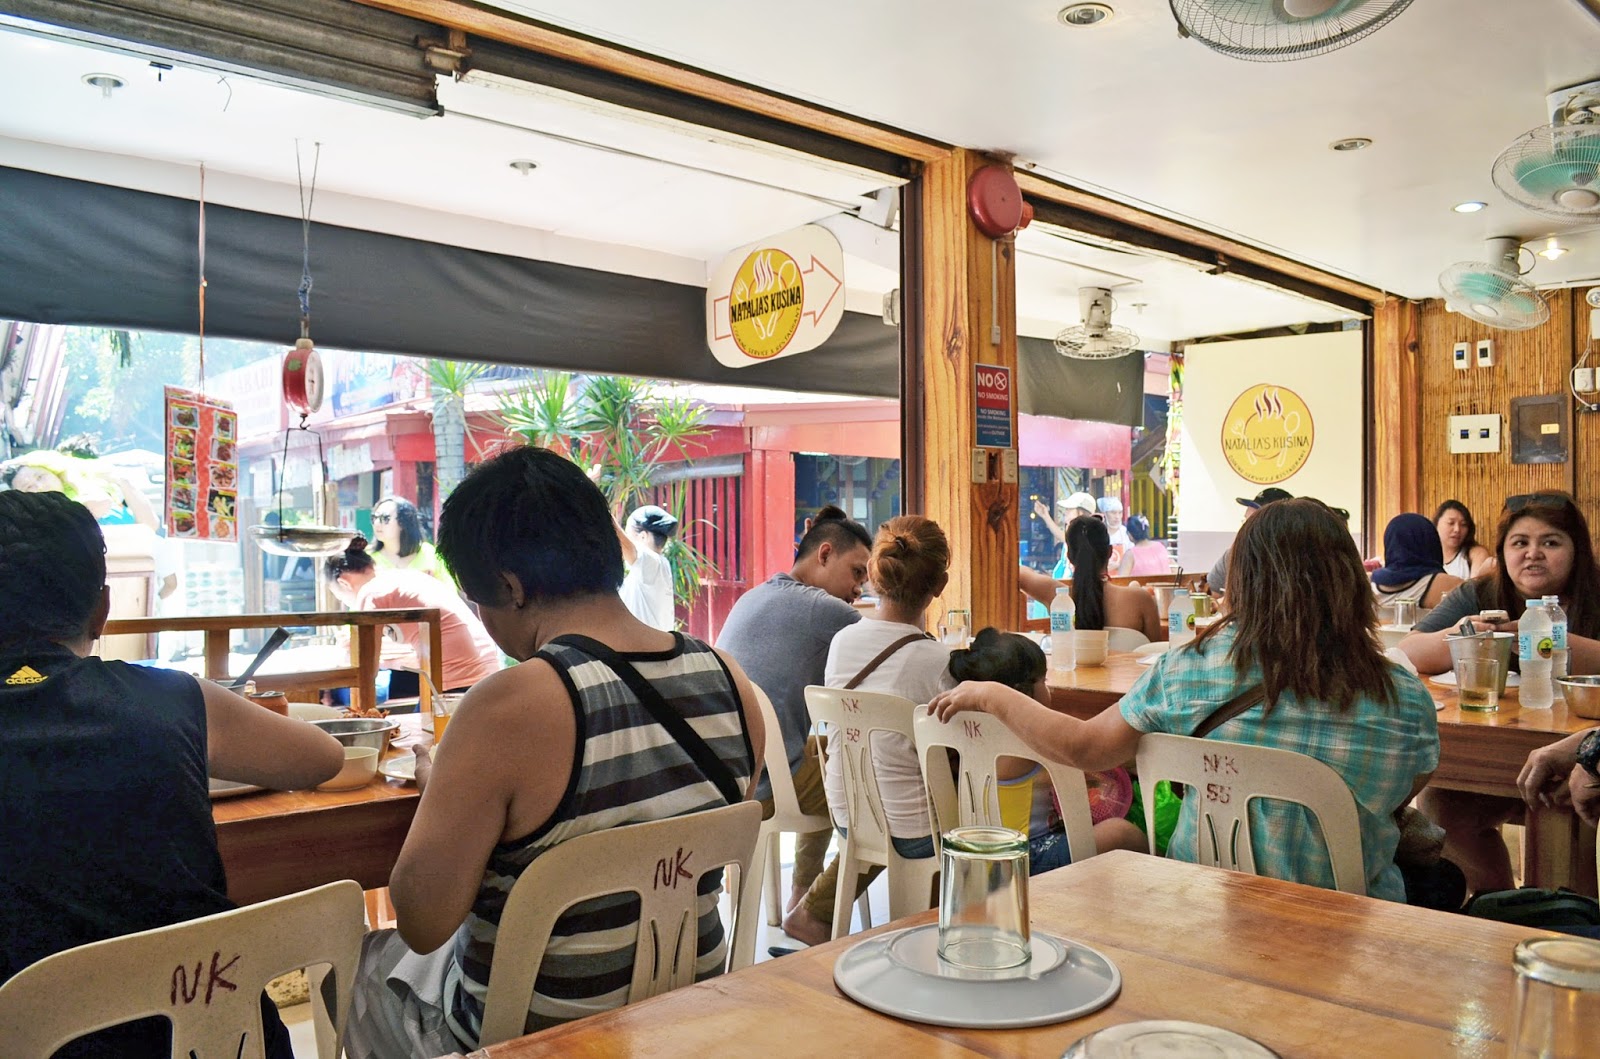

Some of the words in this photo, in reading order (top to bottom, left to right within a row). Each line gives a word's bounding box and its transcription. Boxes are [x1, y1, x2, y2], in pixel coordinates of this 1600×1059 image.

[731, 295, 769, 323] NATALIA'S
[771, 286, 801, 312] KUSINA
[977, 372, 994, 388] NO
[978, 391, 986, 399] NO
[986, 393, 1008, 401] SMOKING
[1225, 438, 1271, 450] NATALIA'S
[1273, 436, 1309, 449] KUSINA
[5, 675, 49, 685] adidas
[841, 698, 862, 713] NK
[963, 720, 983, 739] NK
[1203, 753, 1239, 775] NK
[653, 847, 694, 891] NK
[170, 951, 241, 1007] NK
